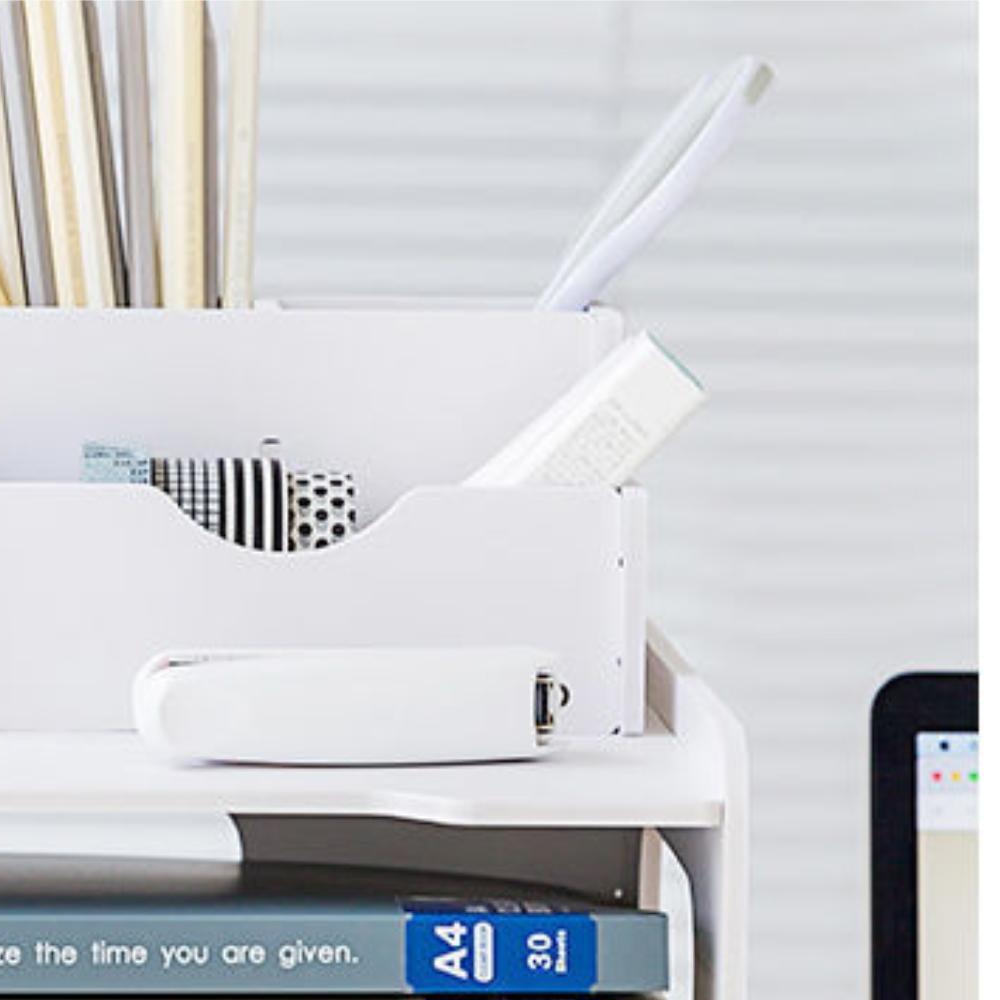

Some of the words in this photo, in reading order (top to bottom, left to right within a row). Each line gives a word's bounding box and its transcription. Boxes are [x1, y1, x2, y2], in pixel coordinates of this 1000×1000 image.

[35, 941, 78, 966] the
[91, 940, 148, 965] time
[160, 945, 209, 969] you
[221, 945, 266, 964] are
[278, 939, 359, 969] given.
[432, 921, 469, 980] A4
[527, 932, 553, 971] 30
[554, 928, 568, 974] Sheets
